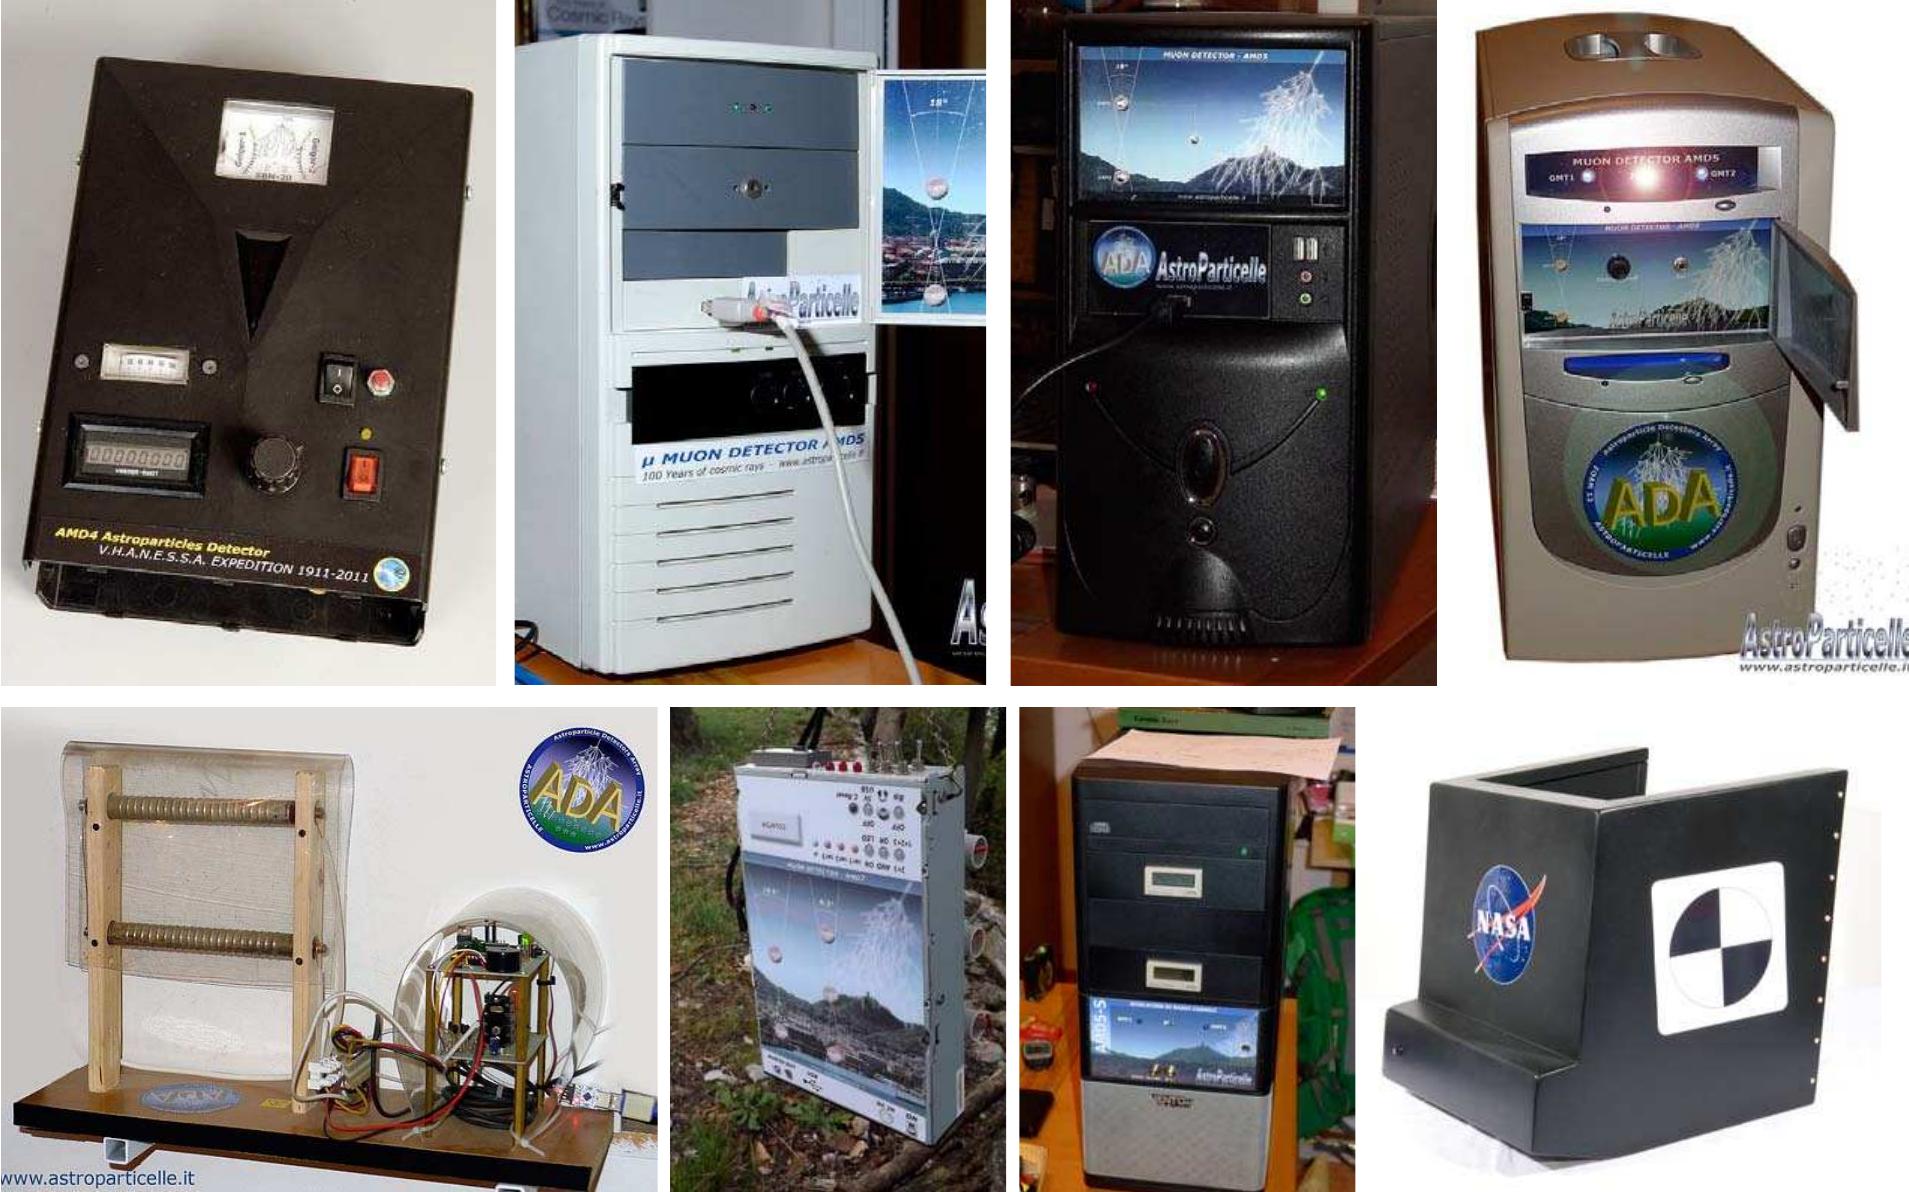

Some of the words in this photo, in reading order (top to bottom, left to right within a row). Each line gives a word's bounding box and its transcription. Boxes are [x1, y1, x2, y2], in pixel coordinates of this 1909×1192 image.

[1162, 50, 1190, 60] MUON
[1190, 50, 1236, 60] DETECTOR
[1573, 157, 1612, 166] MUON
[1615, 154, 1681, 166] DETECTOR
[1684, 153, 1720, 164] AMD5
[1100, 251, 1151, 277] ADA
[1155, 250, 1268, 284] AstroParticelle
[747, 280, 860, 318] AParticelle
[662, 448, 723, 465] MUON
[729, 438, 819, 458] DETECTOR
[822, 432, 866, 449] MD5
[642, 470, 663, 482] 100
[665, 467, 695, 479] Years
[696, 466, 707, 477] of
[708, 463, 743, 475] cosmic
[744, 462, 764, 474] rays
[1601, 467, 1722, 530] ADA
[55, 527, 98, 541] AMD4
[101, 530, 204, 552] Astroparticles
[206, 542, 271, 558] Detector
[98, 544, 207, 566] V.H.A.N.E.S.S.A.
[211, 556, 294, 575] EXPEDITION
[297, 564, 370, 583] 1911-2011
[1476, 909, 1531, 942] NASA
